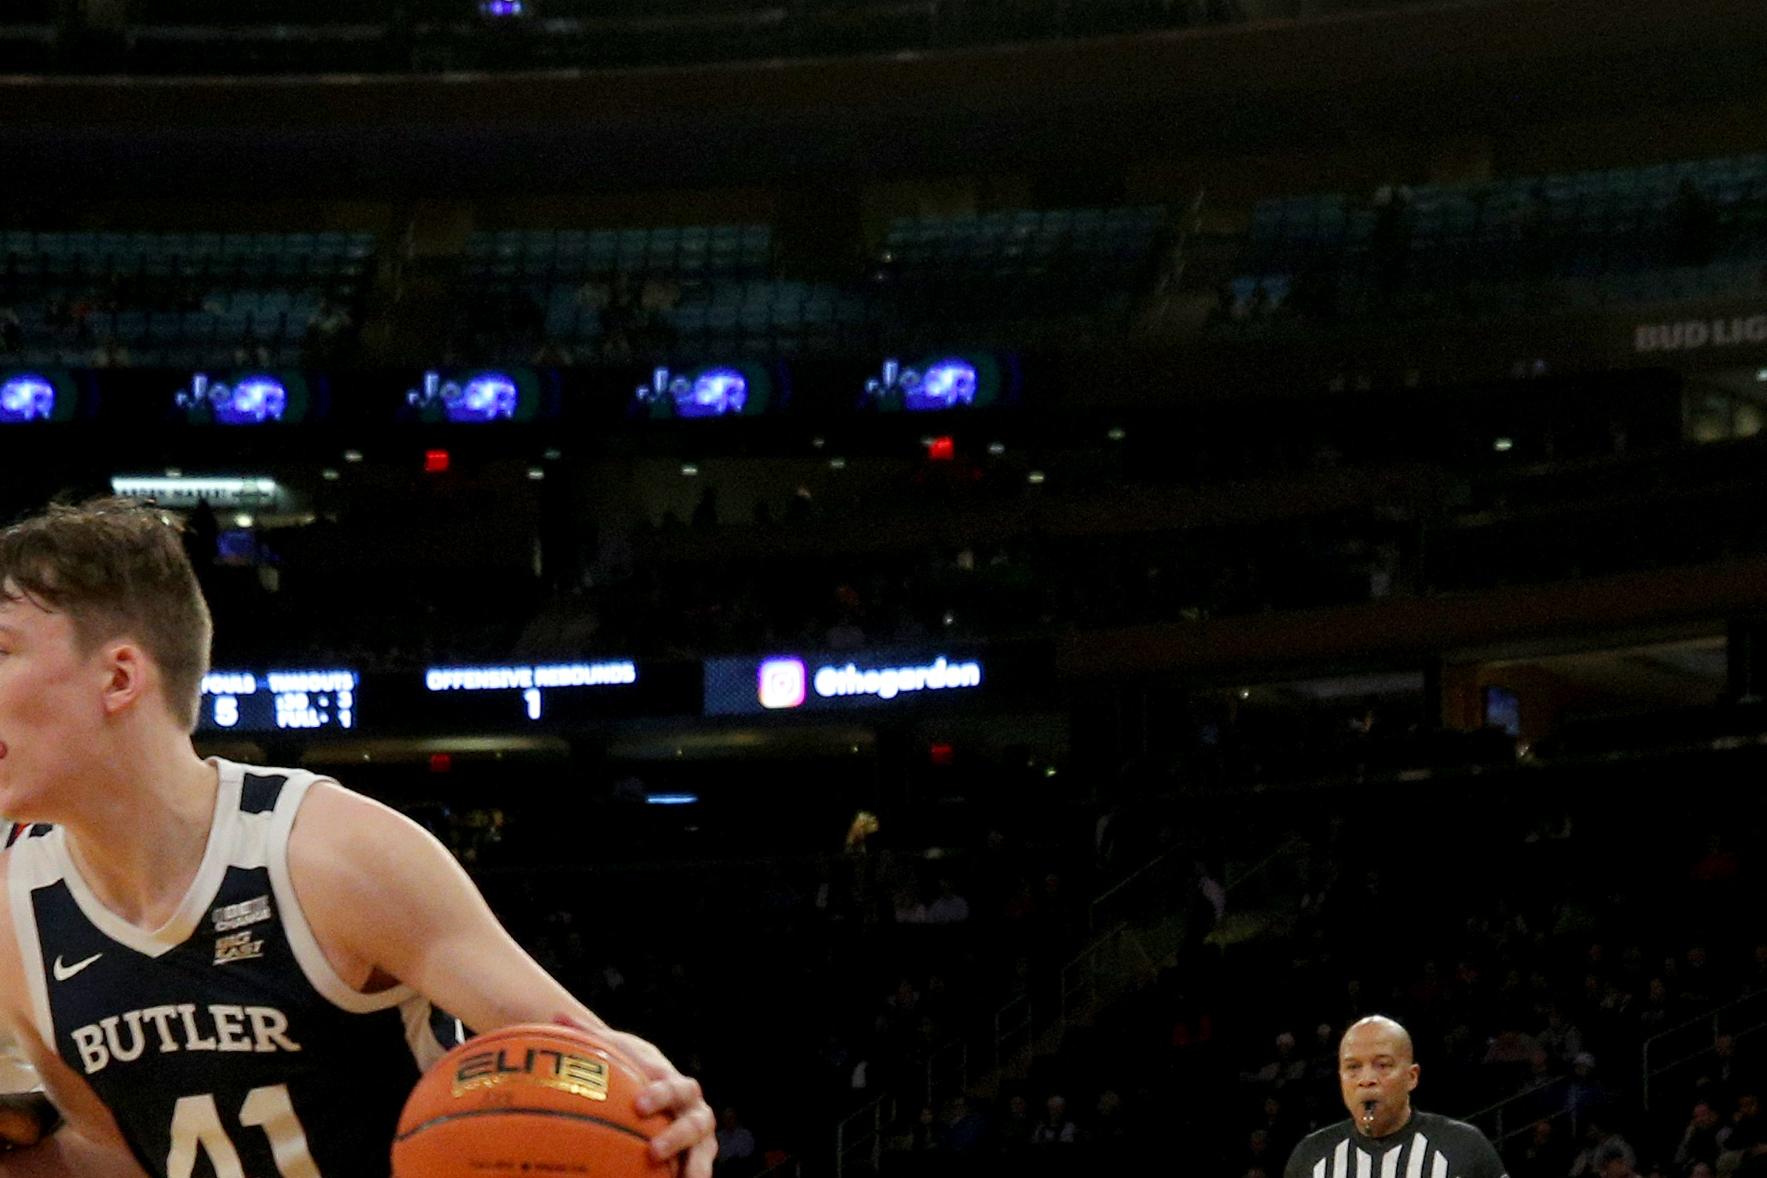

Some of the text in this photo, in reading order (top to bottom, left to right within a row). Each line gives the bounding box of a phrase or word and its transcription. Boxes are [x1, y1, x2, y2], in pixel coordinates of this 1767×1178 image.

[1635, 320, 1709, 351] BUD
[426, 661, 637, 691] OFFENSIVE REBOUNDS
[213, 695, 240, 727] 5
[523, 687, 542, 720] 1
[71, 1004, 302, 1075] BUTLER
